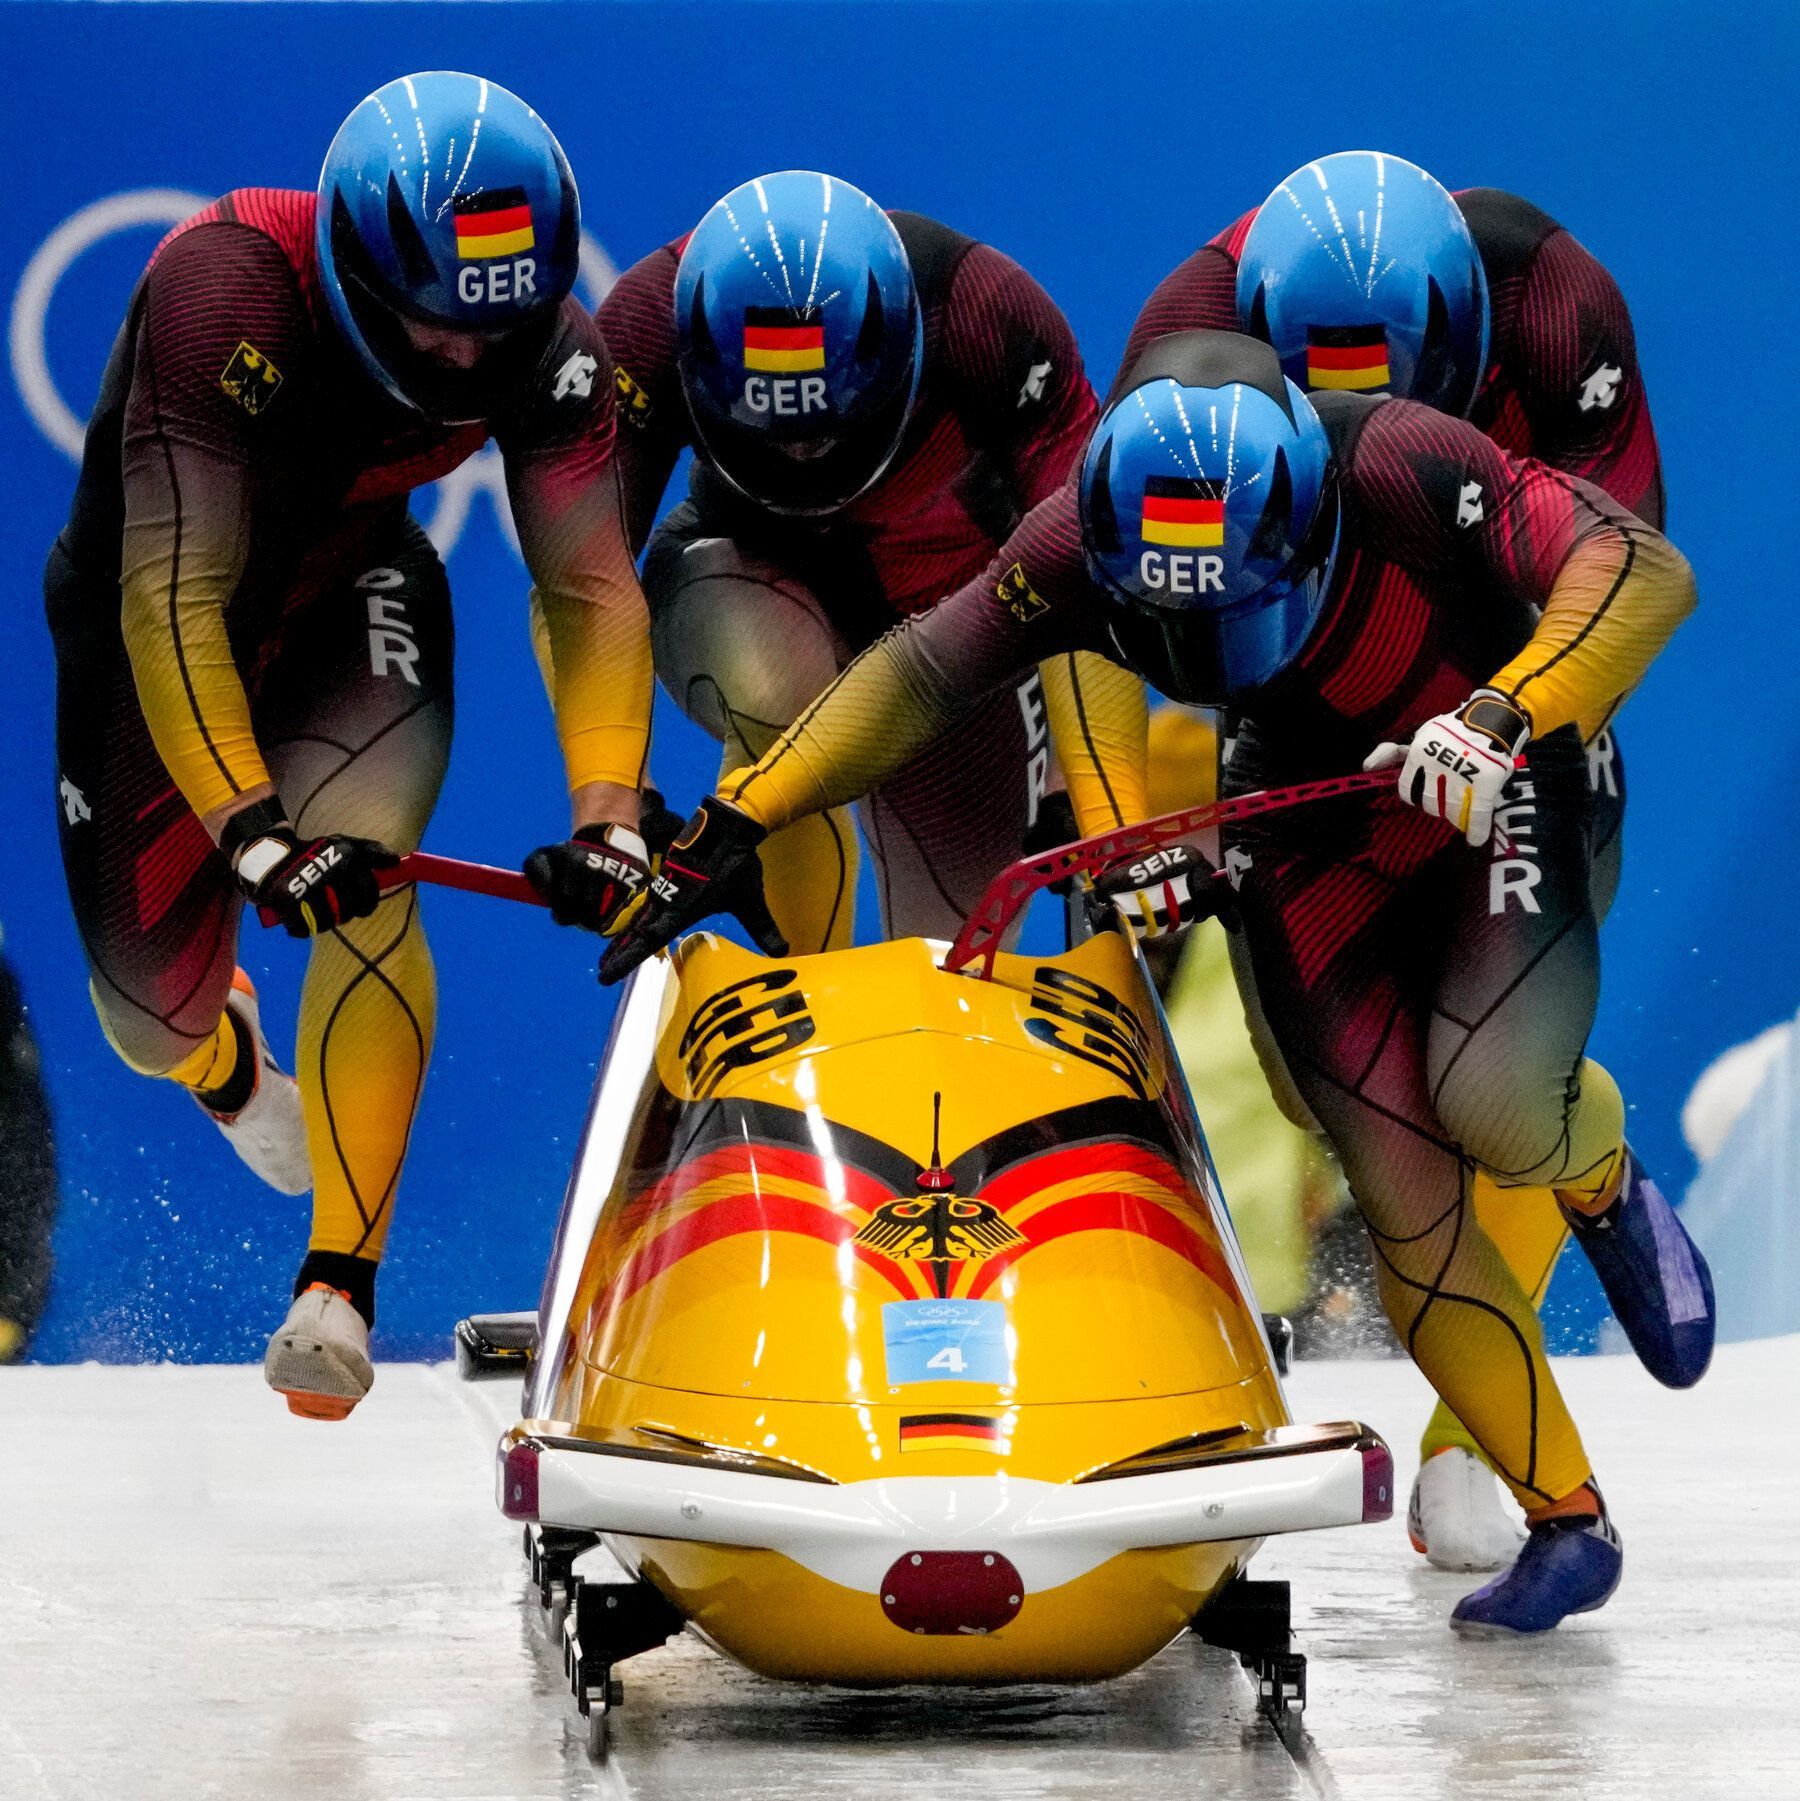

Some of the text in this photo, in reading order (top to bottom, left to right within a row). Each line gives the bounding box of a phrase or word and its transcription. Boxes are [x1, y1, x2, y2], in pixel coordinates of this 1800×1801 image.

[458, 258, 537, 303] GER
[745, 377, 828, 415] GER
[1140, 551, 1226, 593] GER
[926, 1347, 968, 1373] 4
